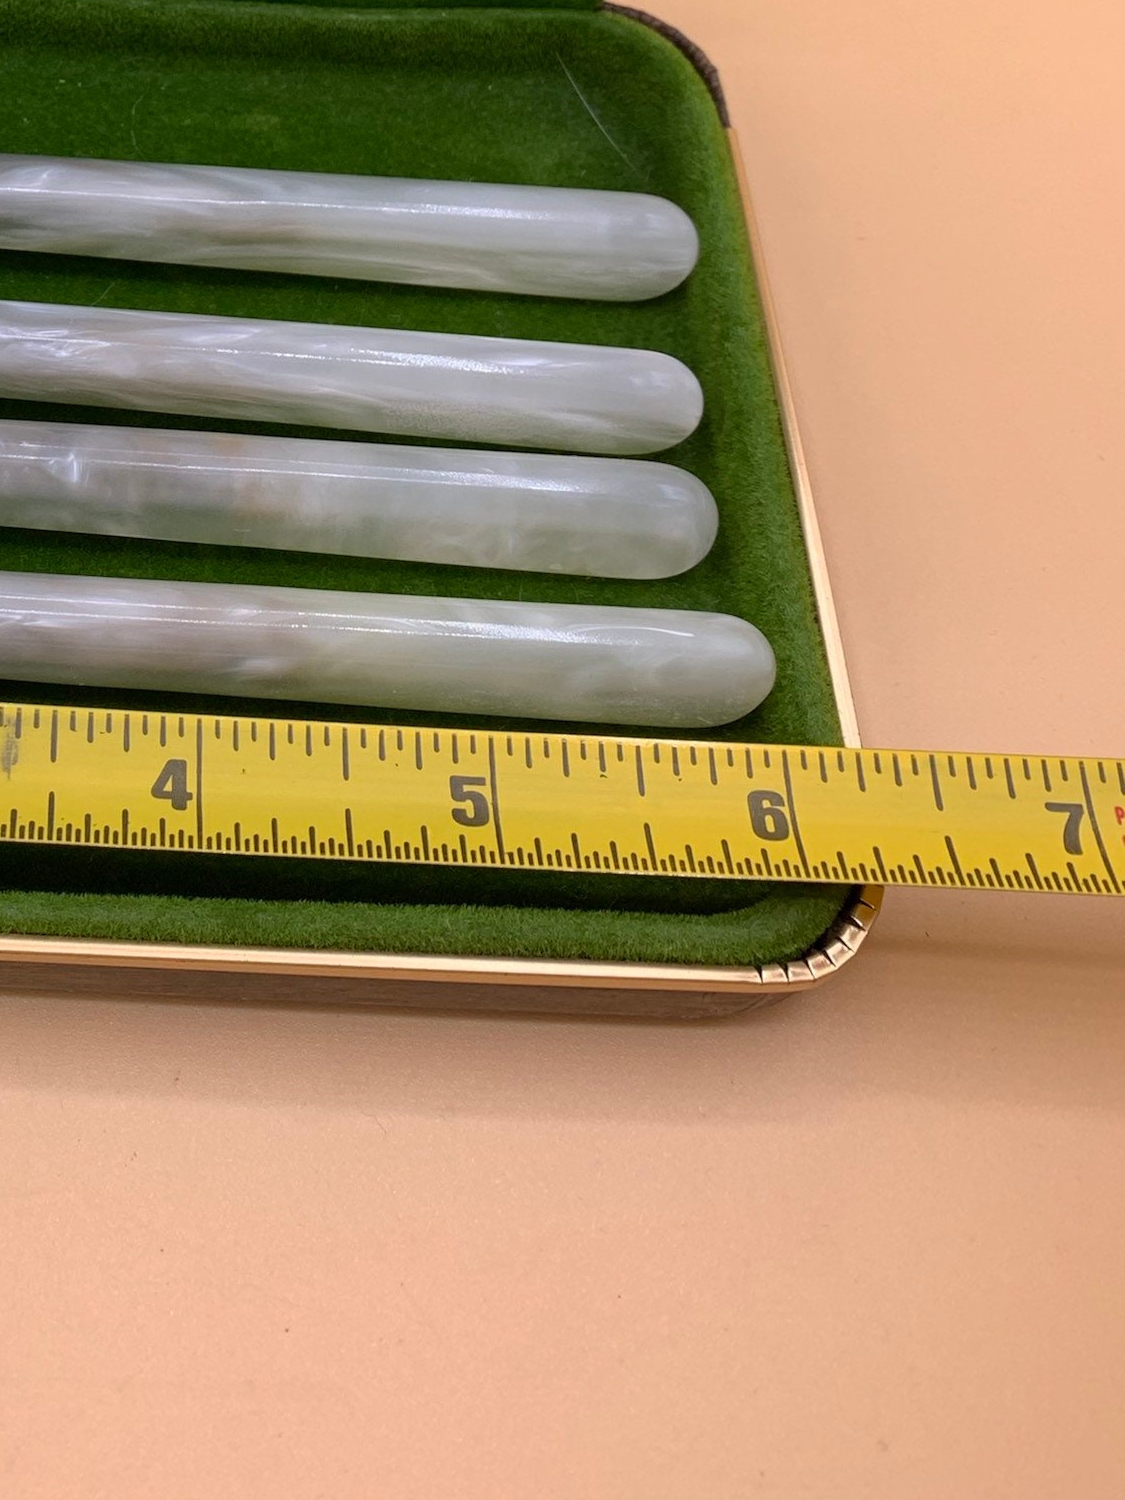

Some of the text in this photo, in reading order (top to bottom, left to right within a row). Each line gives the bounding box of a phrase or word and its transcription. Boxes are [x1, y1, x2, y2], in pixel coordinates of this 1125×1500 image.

[150, 759, 193, 811] 4
[449, 775, 490, 827] 5
[747, 790, 789, 841] 6
[1044, 802, 1084, 855] 7
